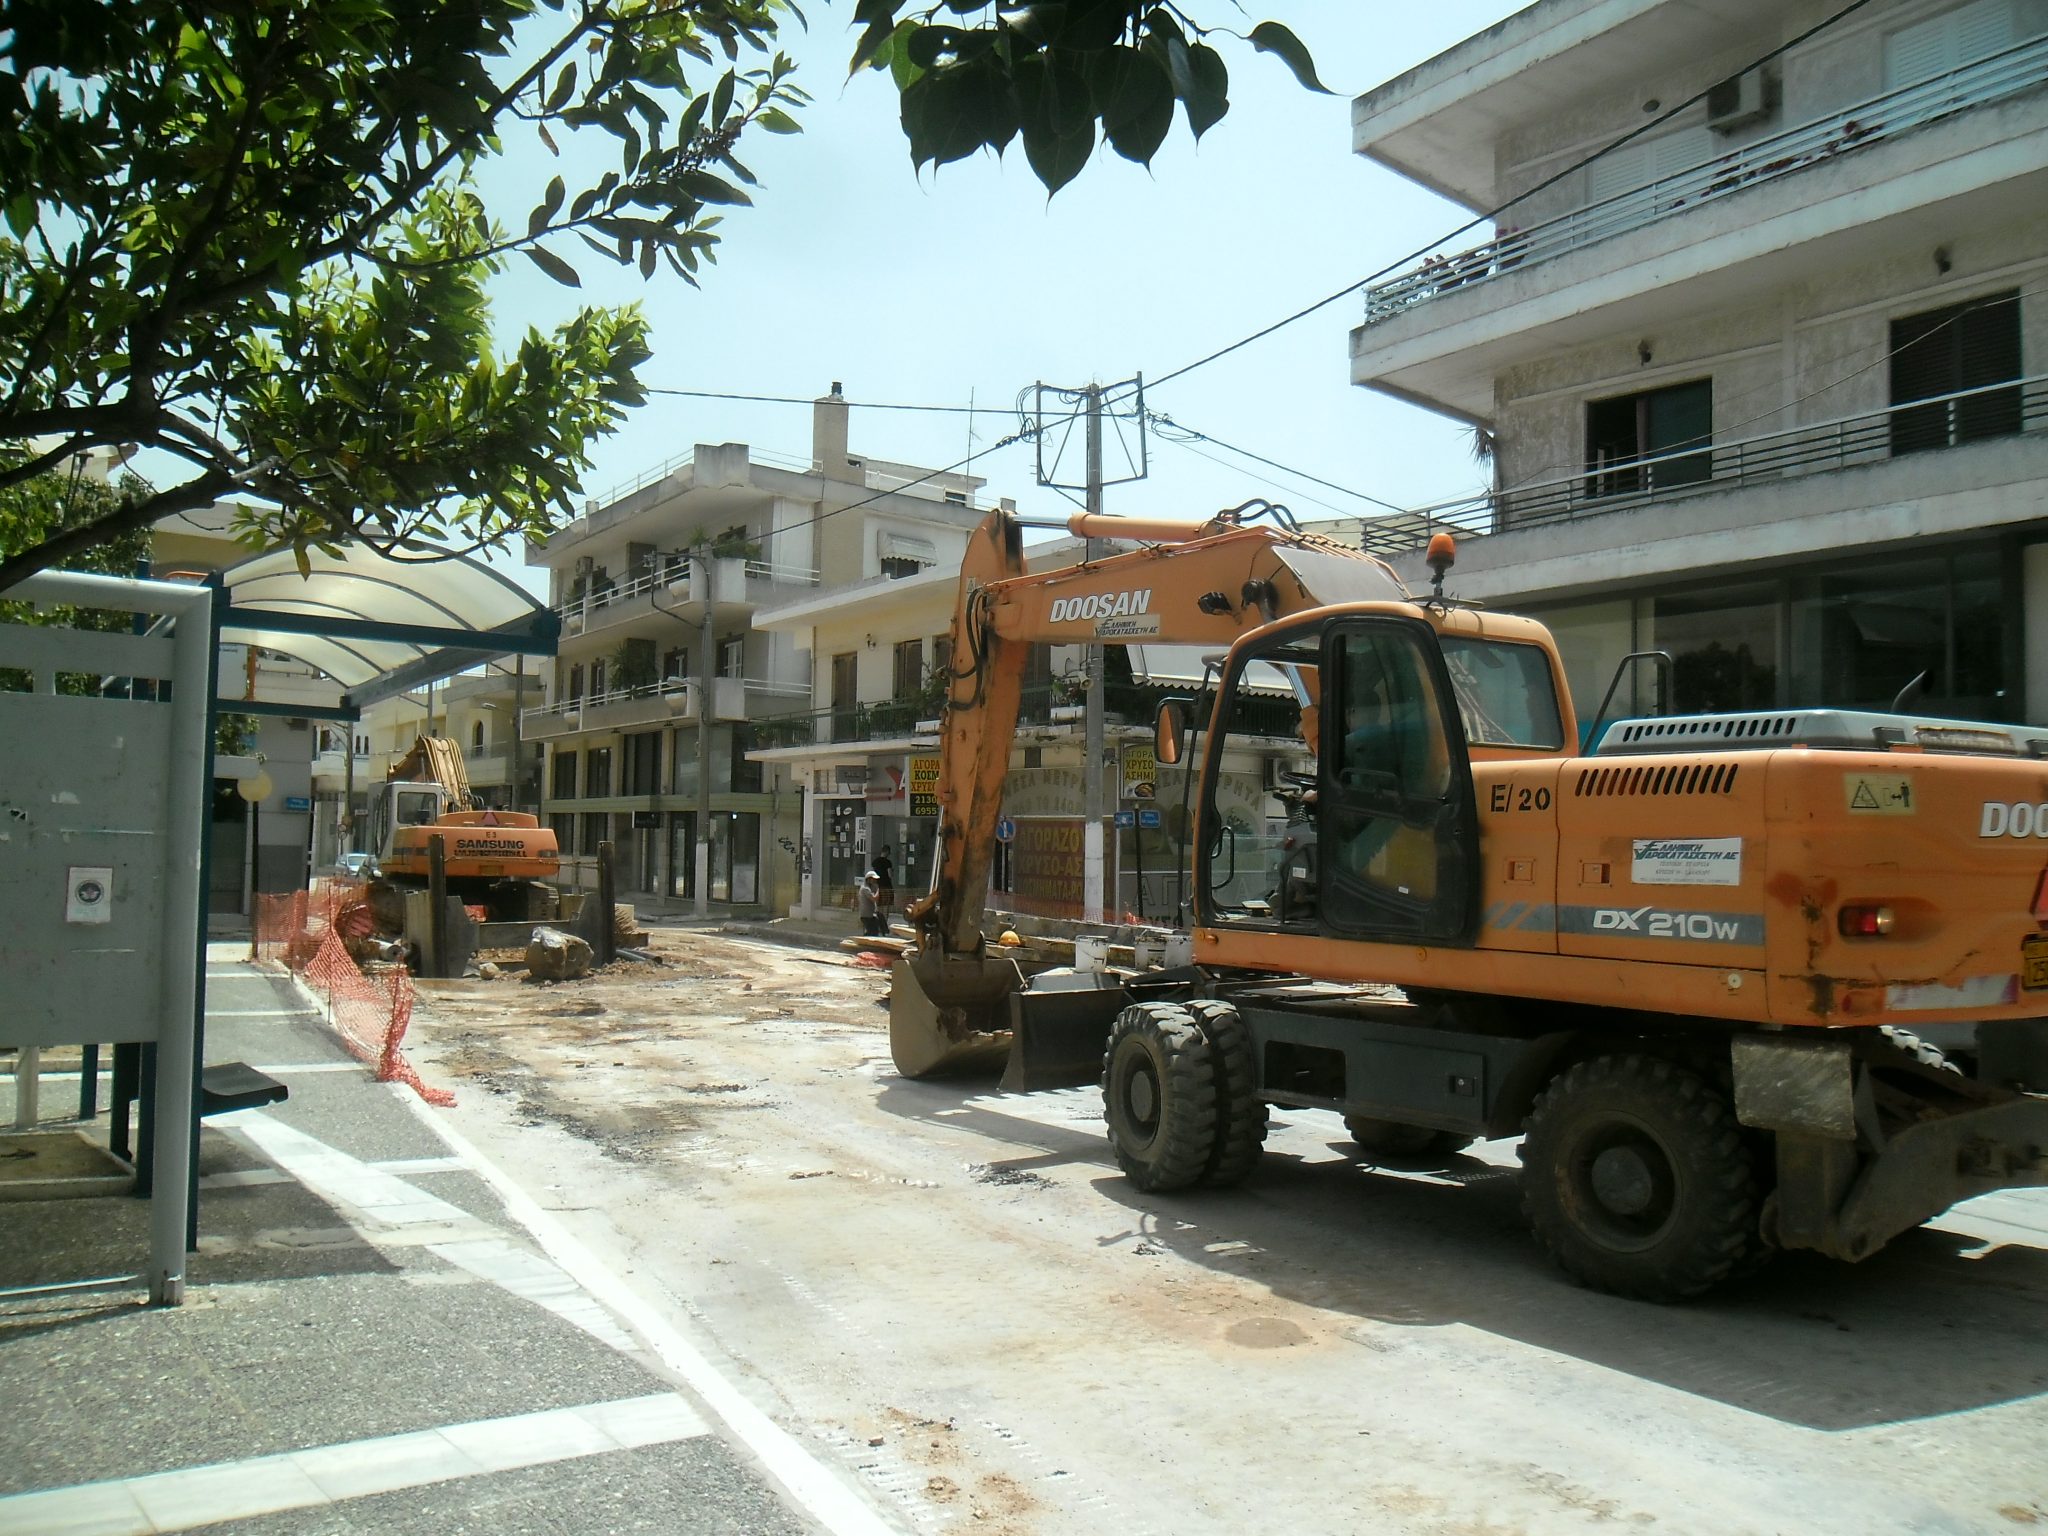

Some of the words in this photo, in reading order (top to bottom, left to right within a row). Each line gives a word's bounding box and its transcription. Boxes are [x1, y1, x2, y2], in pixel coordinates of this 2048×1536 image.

[1049, 589, 1151, 623] DOOSAN
[1126, 760, 1153, 770] ΧΡΥΣΟ
[1125, 771, 1154, 780] ΑΣΗΜΙ
[457, 840, 524, 849] SAMSUNG
[1593, 906, 1653, 930] DX
